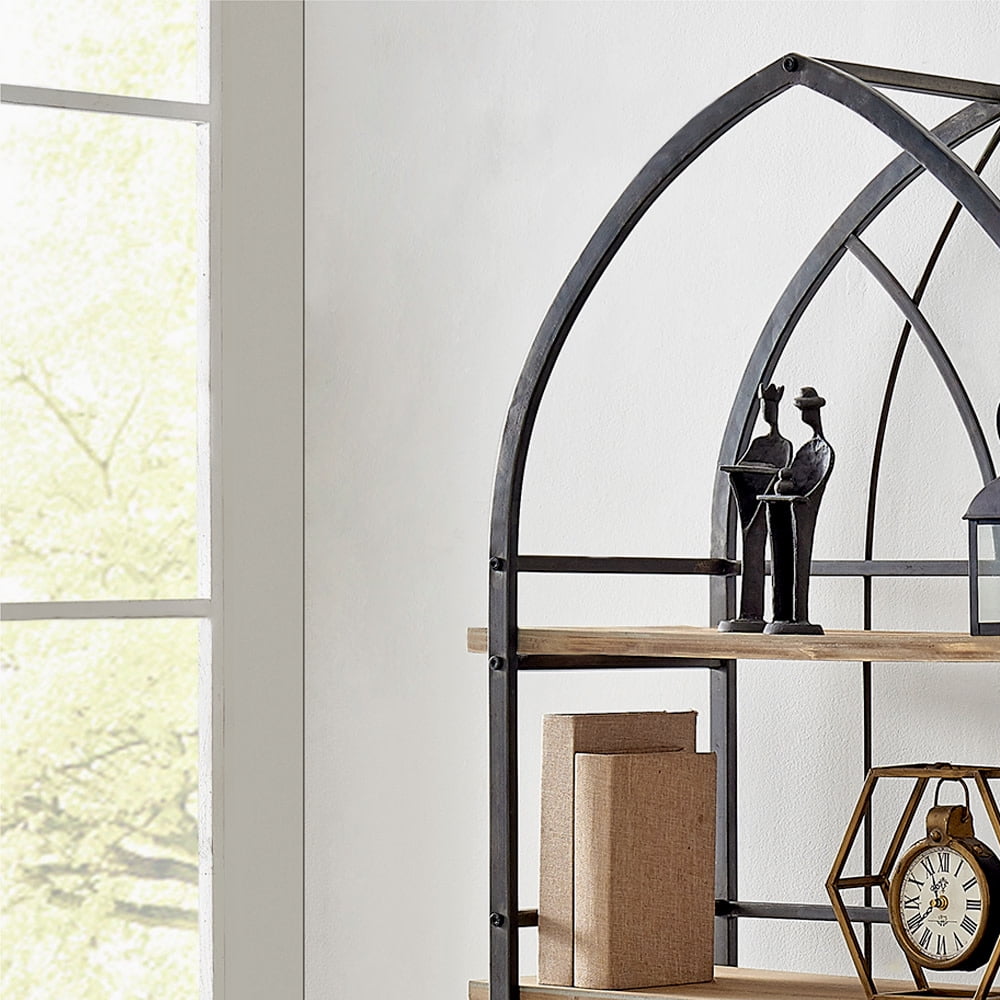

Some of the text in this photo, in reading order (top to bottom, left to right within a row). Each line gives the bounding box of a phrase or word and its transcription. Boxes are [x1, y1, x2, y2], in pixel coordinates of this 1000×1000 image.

[921, 857, 935, 877] XI
[938, 853, 950, 873] XII
[954, 860, 964, 877] I
[908, 873, 924, 891] X
[962, 877, 977, 892] II
[904, 895, 920, 909] IX
[966, 899, 981, 910] III
[919, 928, 932, 950] VII
[936, 935, 947, 955] VI
[953, 932, 964, 951] V
